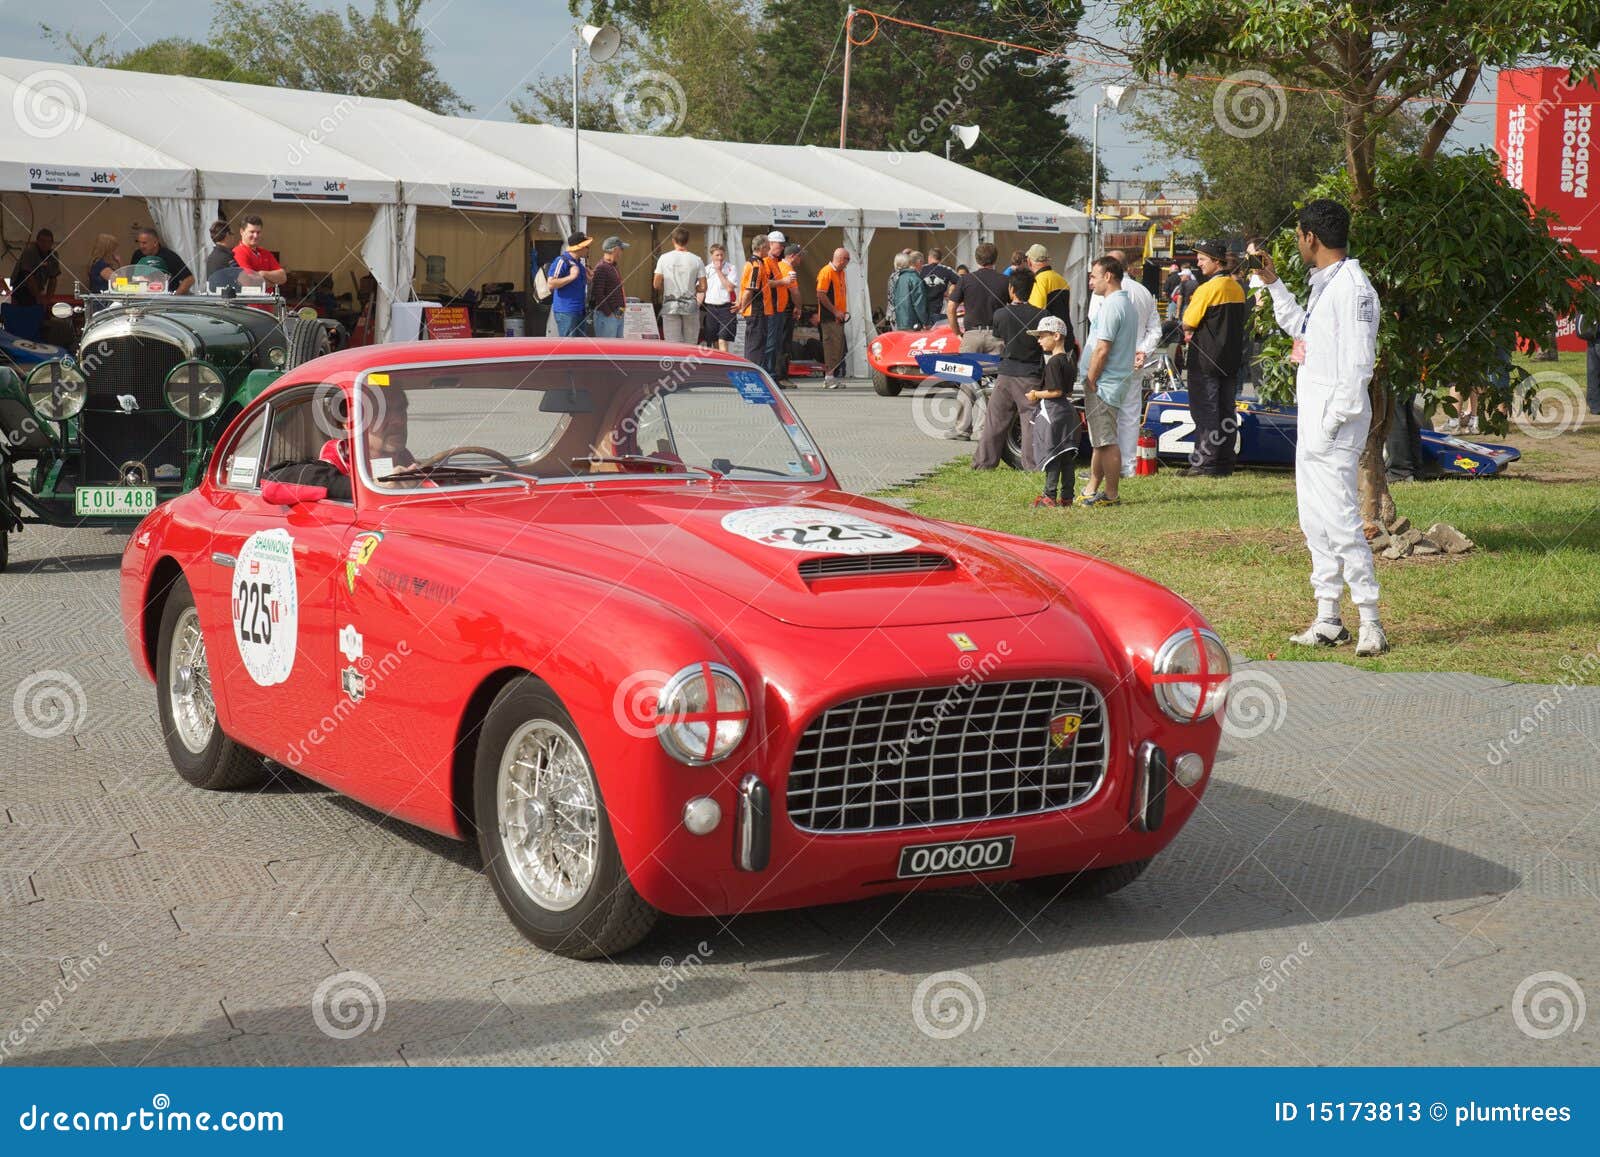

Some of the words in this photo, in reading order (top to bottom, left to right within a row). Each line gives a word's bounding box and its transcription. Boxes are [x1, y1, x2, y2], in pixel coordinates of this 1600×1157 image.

[1560, 108, 1578, 193] SUPPORT
[1574, 103, 1593, 198] PADDOCK
[29, 168, 42, 179] 99
[90, 171, 109, 184] Jet
[272, 179, 277, 189] 7
[323, 181, 339, 192] Jet
[451, 187, 461, 197] 65
[496, 190, 509, 201] Jet
[660, 202, 672, 212] Jet
[910, 337, 948, 351] 44
[941, 363, 957, 373] Jet
[771, 524, 893, 545] 225
[254, 536, 291, 556] SHANNONS
[239, 579, 272, 645] 225
